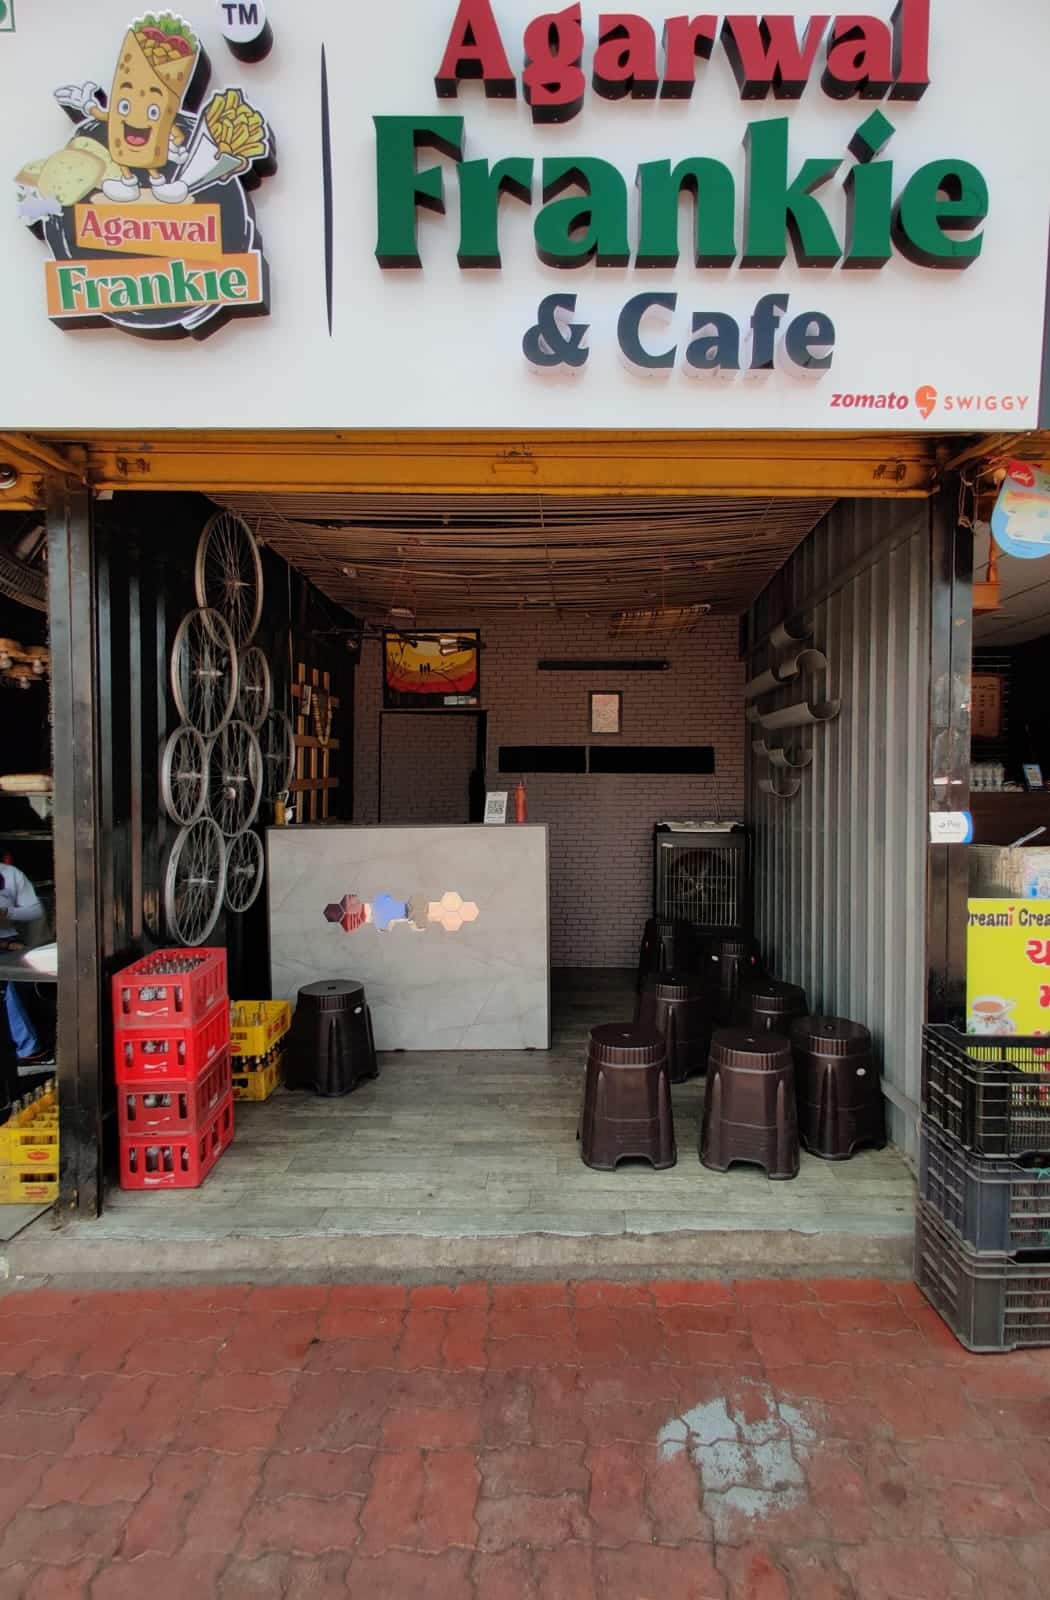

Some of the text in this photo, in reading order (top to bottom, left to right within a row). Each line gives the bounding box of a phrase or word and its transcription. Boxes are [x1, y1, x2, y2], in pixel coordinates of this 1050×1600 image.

[222, 3, 259, 25] TM
[436, 0, 930, 107] Agarwal
[373, 109, 989, 262] Frankie
[81, 210, 217, 246] Agarwal
[56, 260, 248, 311] Frankie
[522, 292, 836, 370] & Cafe
[830, 391, 909, 410] zomato
[943, 395, 1029, 411] SWIGGY
[967, 906, 1015, 927] reami
